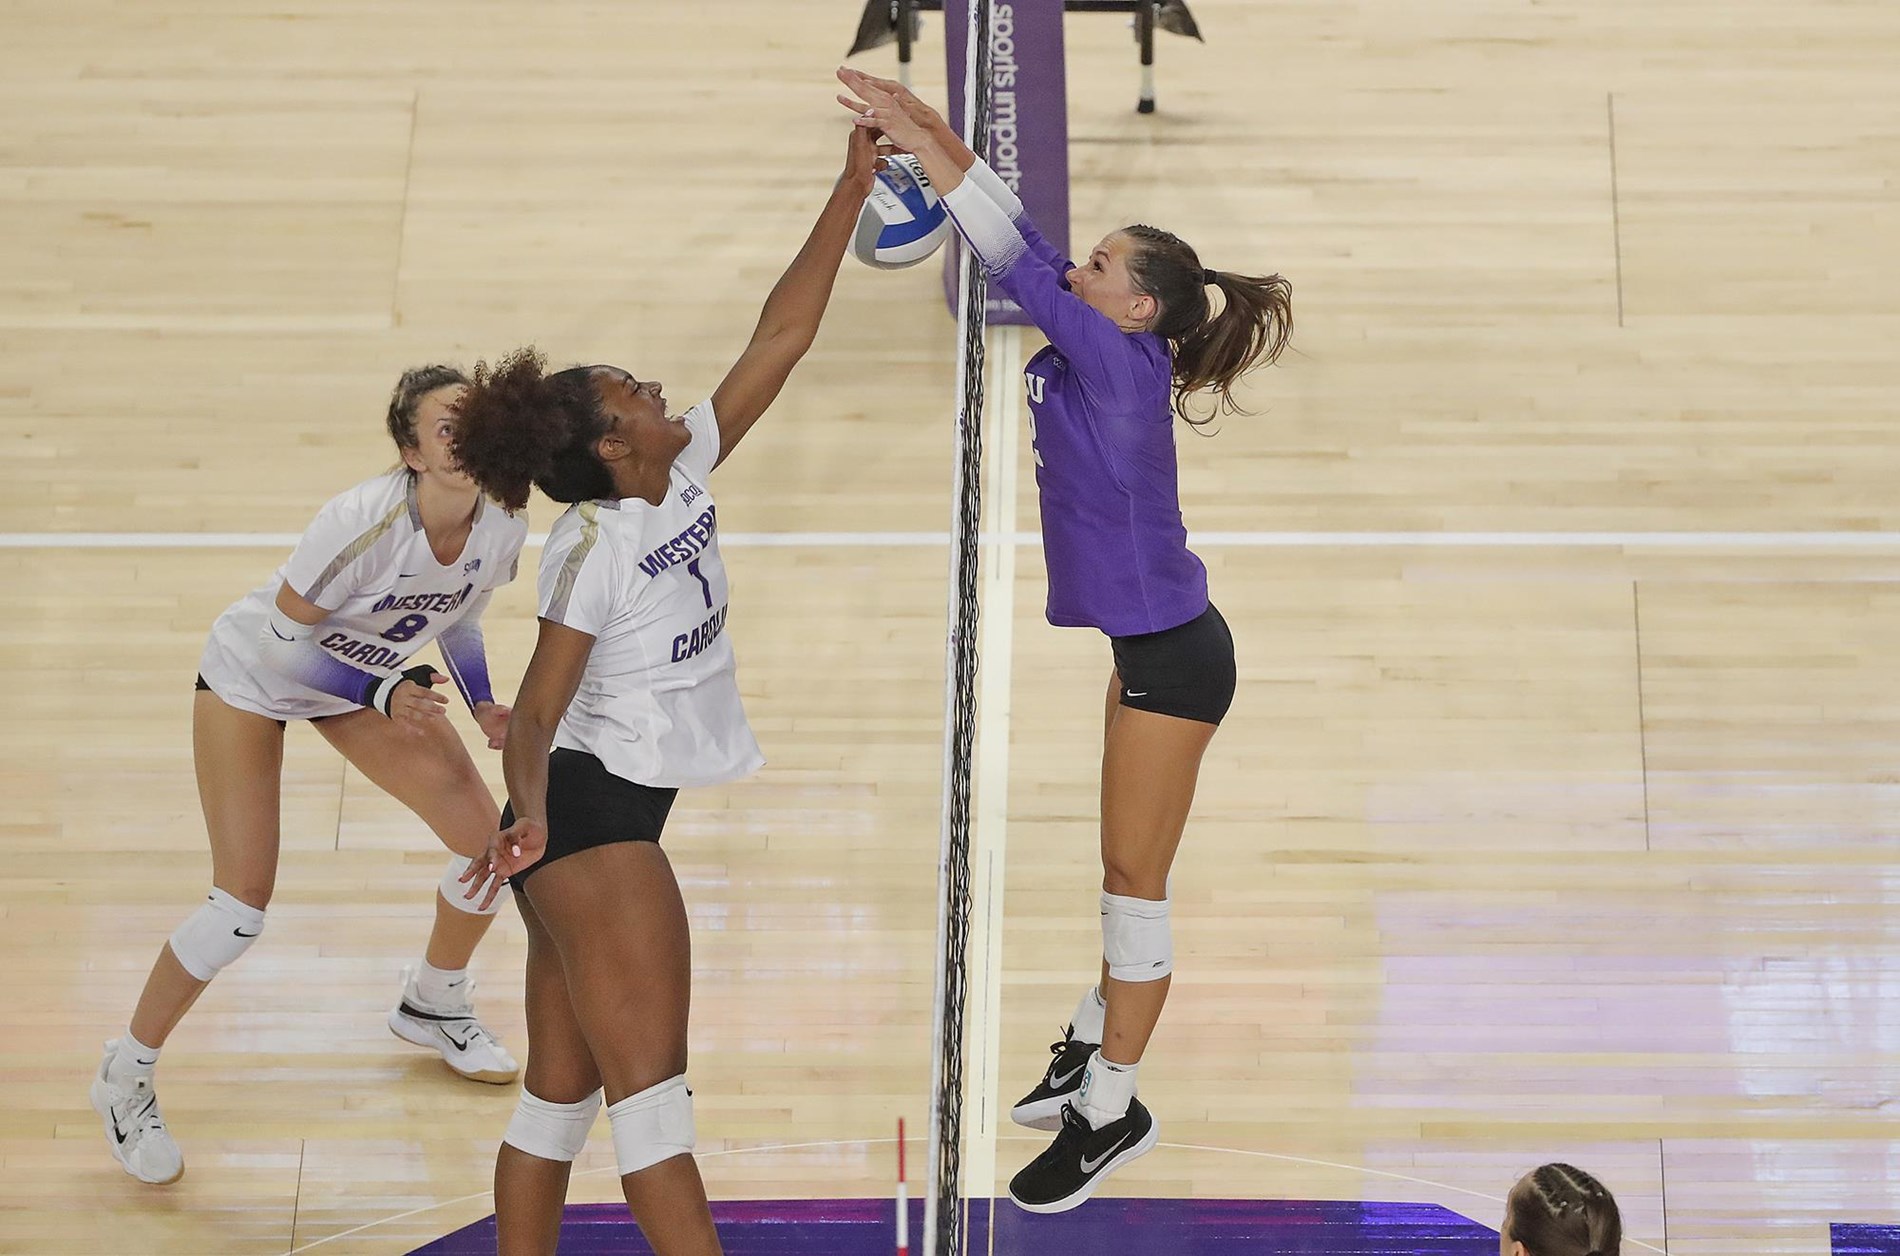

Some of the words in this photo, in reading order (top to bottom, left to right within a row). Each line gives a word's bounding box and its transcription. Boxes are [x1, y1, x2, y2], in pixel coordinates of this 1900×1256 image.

[992, 3, 1020, 88] sports
[687, 557, 713, 610] 1
[379, 614, 429, 643] 8
